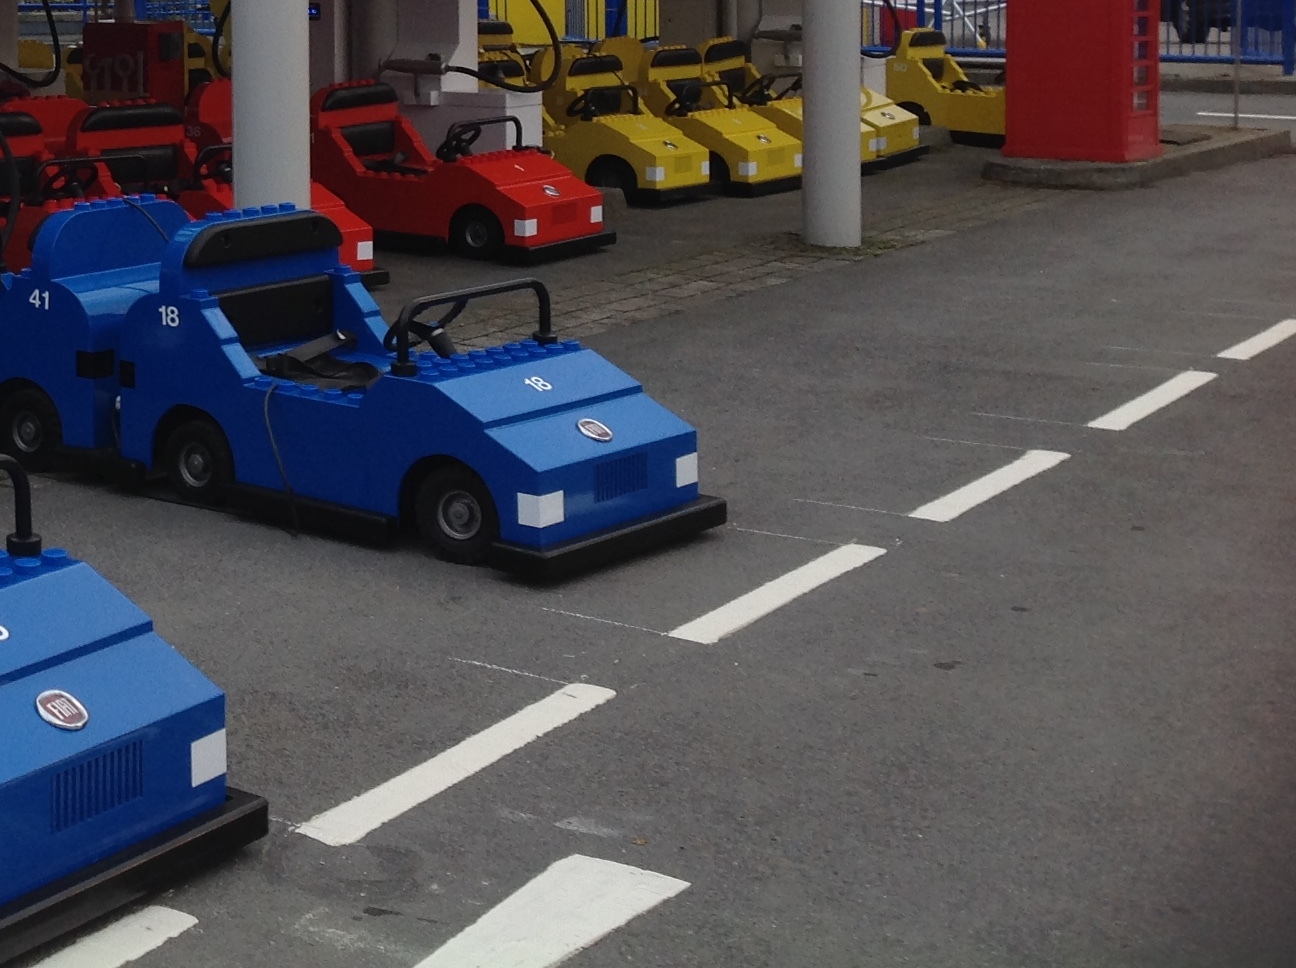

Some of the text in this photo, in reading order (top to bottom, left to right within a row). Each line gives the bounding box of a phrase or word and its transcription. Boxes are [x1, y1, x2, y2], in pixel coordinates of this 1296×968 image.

[28, 289, 50, 310] 41
[158, 305, 180, 327] 18
[524, 376, 553, 392] 18
[46, 698, 79, 720] FIAT
